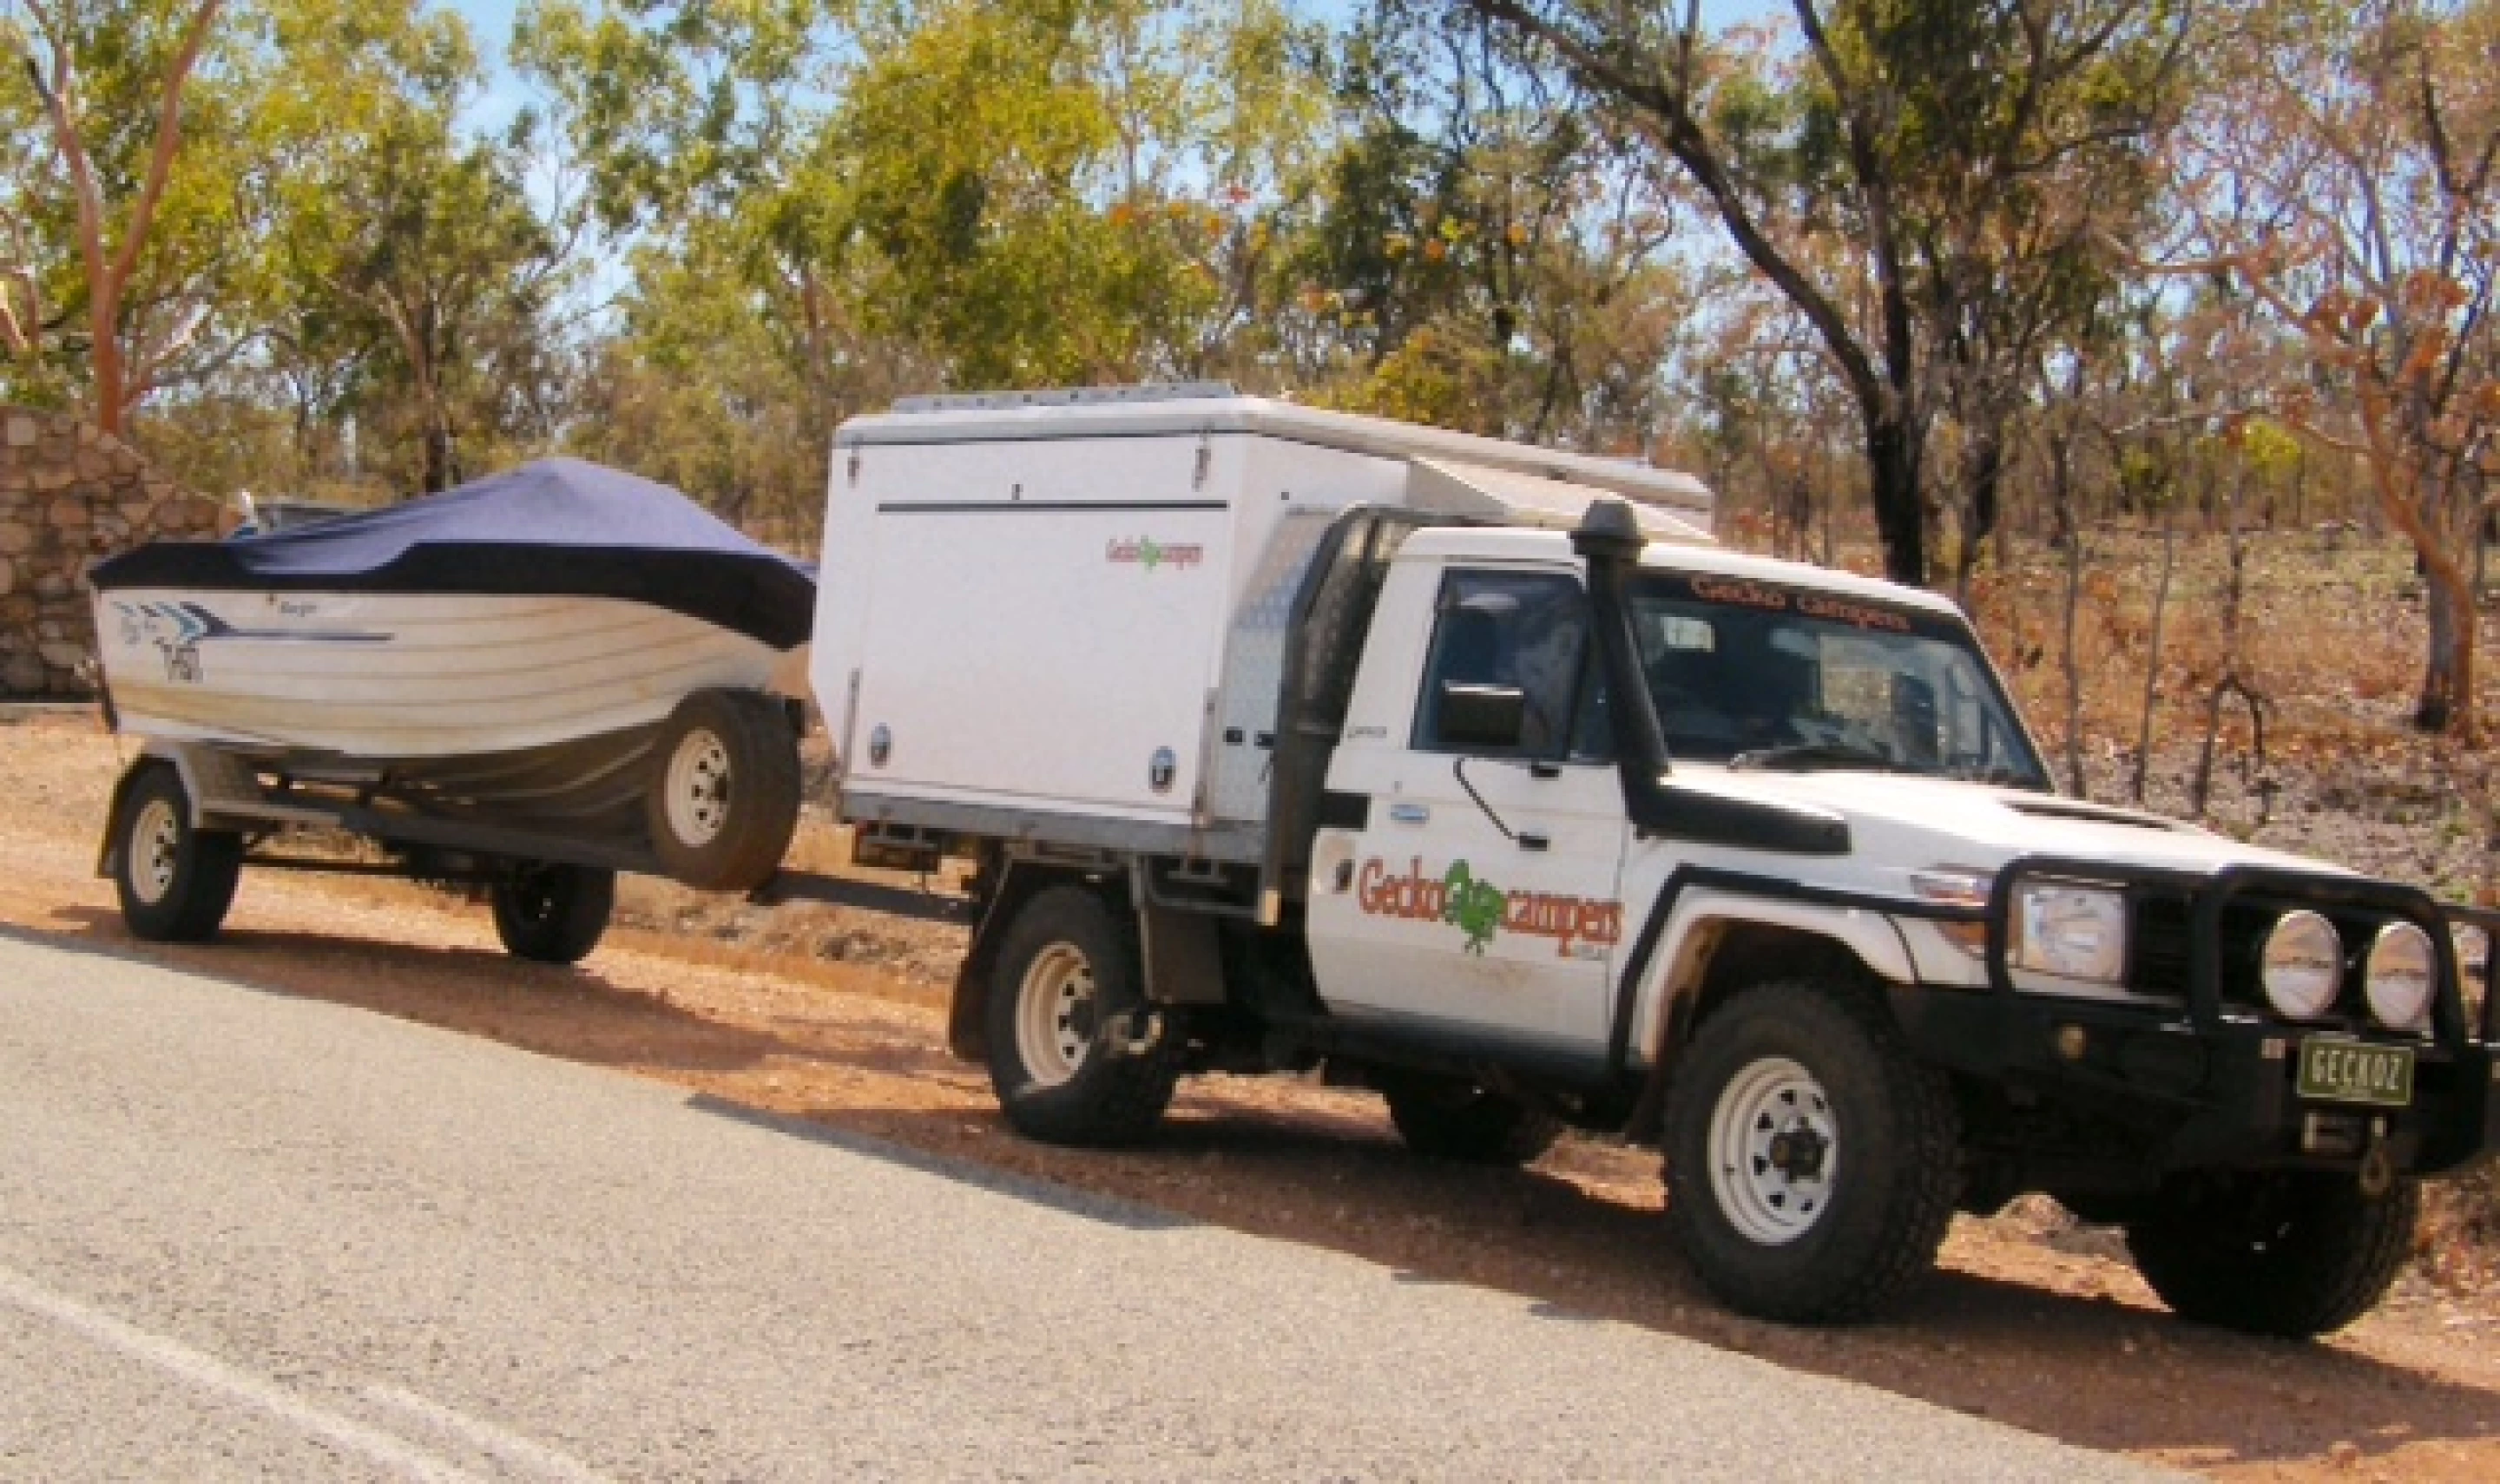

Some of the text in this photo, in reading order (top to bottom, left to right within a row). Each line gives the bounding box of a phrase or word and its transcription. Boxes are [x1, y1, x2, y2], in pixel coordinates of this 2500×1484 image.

[1689, 573, 1786, 608] Gecko
[1359, 856, 1624, 956] Gecko campers
